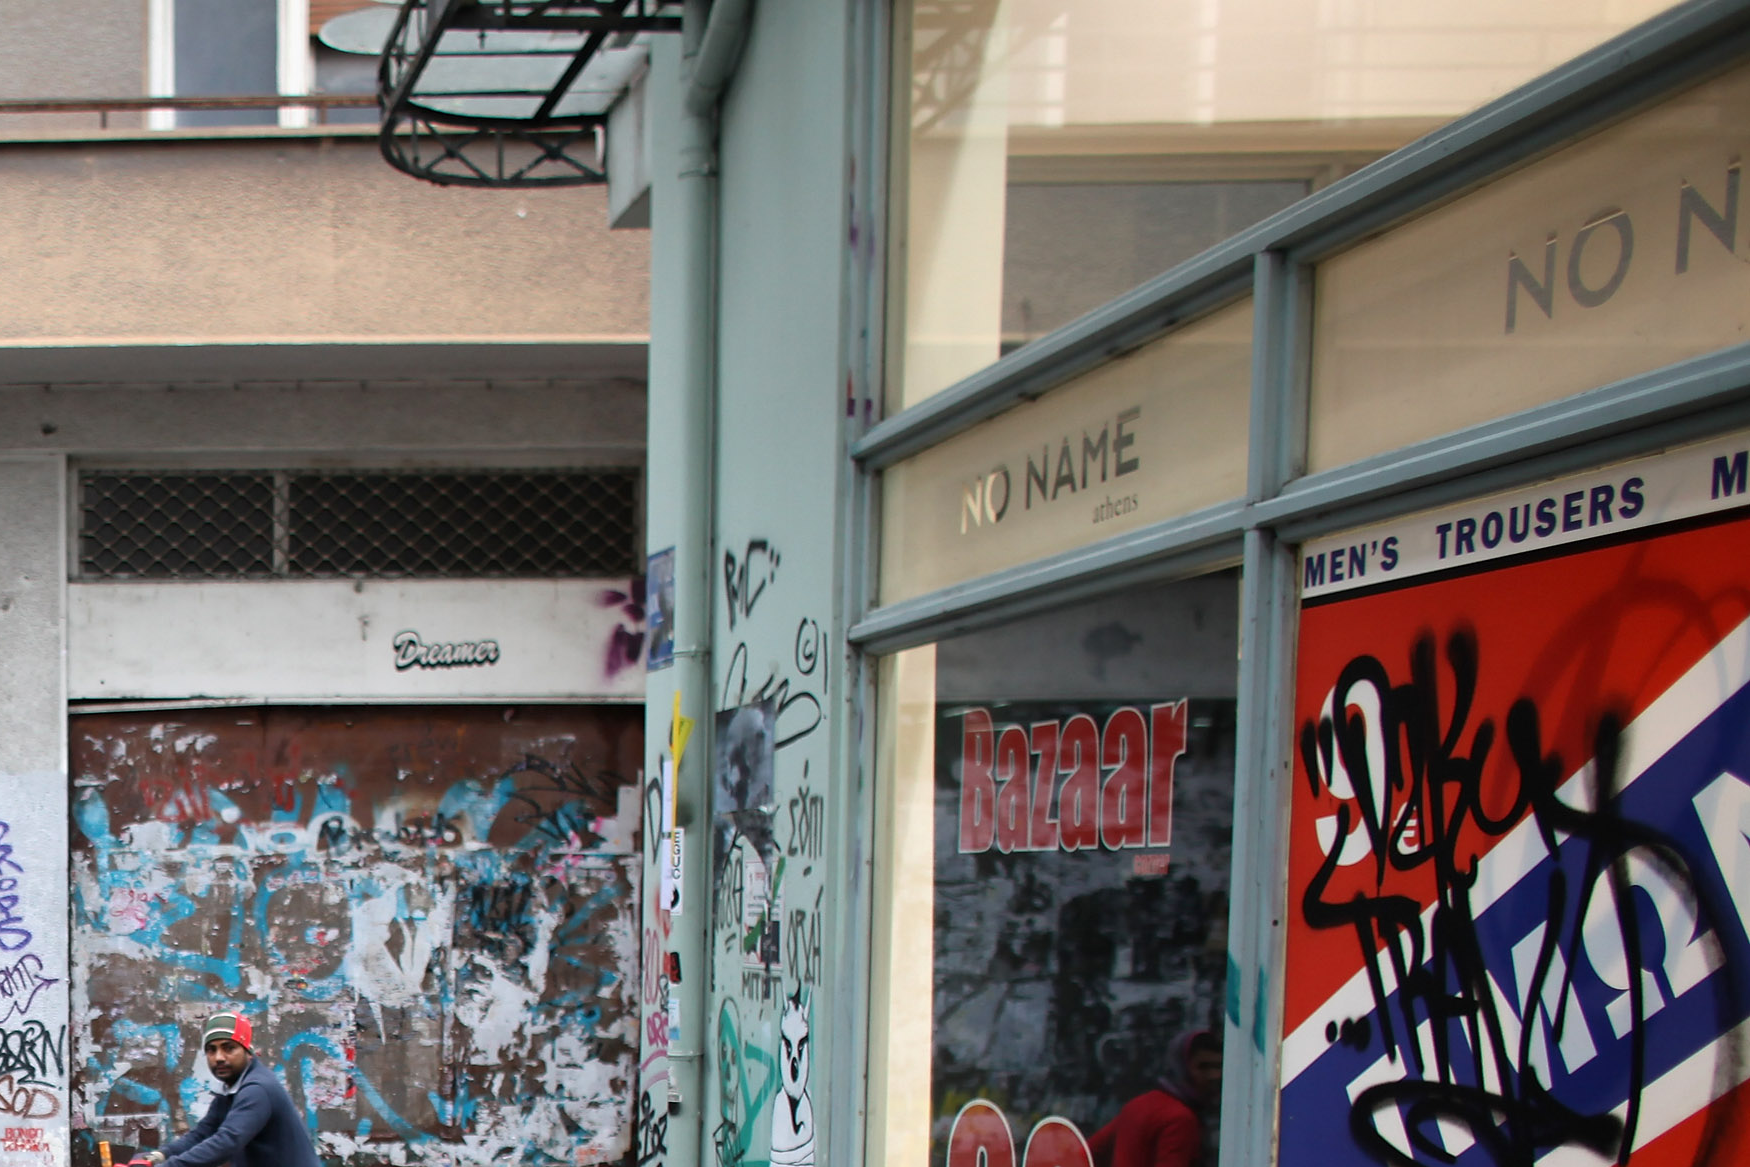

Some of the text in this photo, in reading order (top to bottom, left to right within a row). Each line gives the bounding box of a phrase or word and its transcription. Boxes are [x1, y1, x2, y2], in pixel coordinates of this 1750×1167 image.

[1505, 205, 1634, 335] NO
[961, 405, 1141, 535] NO NAME
[1093, 494, 1138, 524] athens
[1304, 536, 1400, 588] MEN'S
[1436, 477, 1645, 560] TROUSERS
[393, 631, 500, 672] Dreamer
[957, 697, 1188, 854] Bazaar
